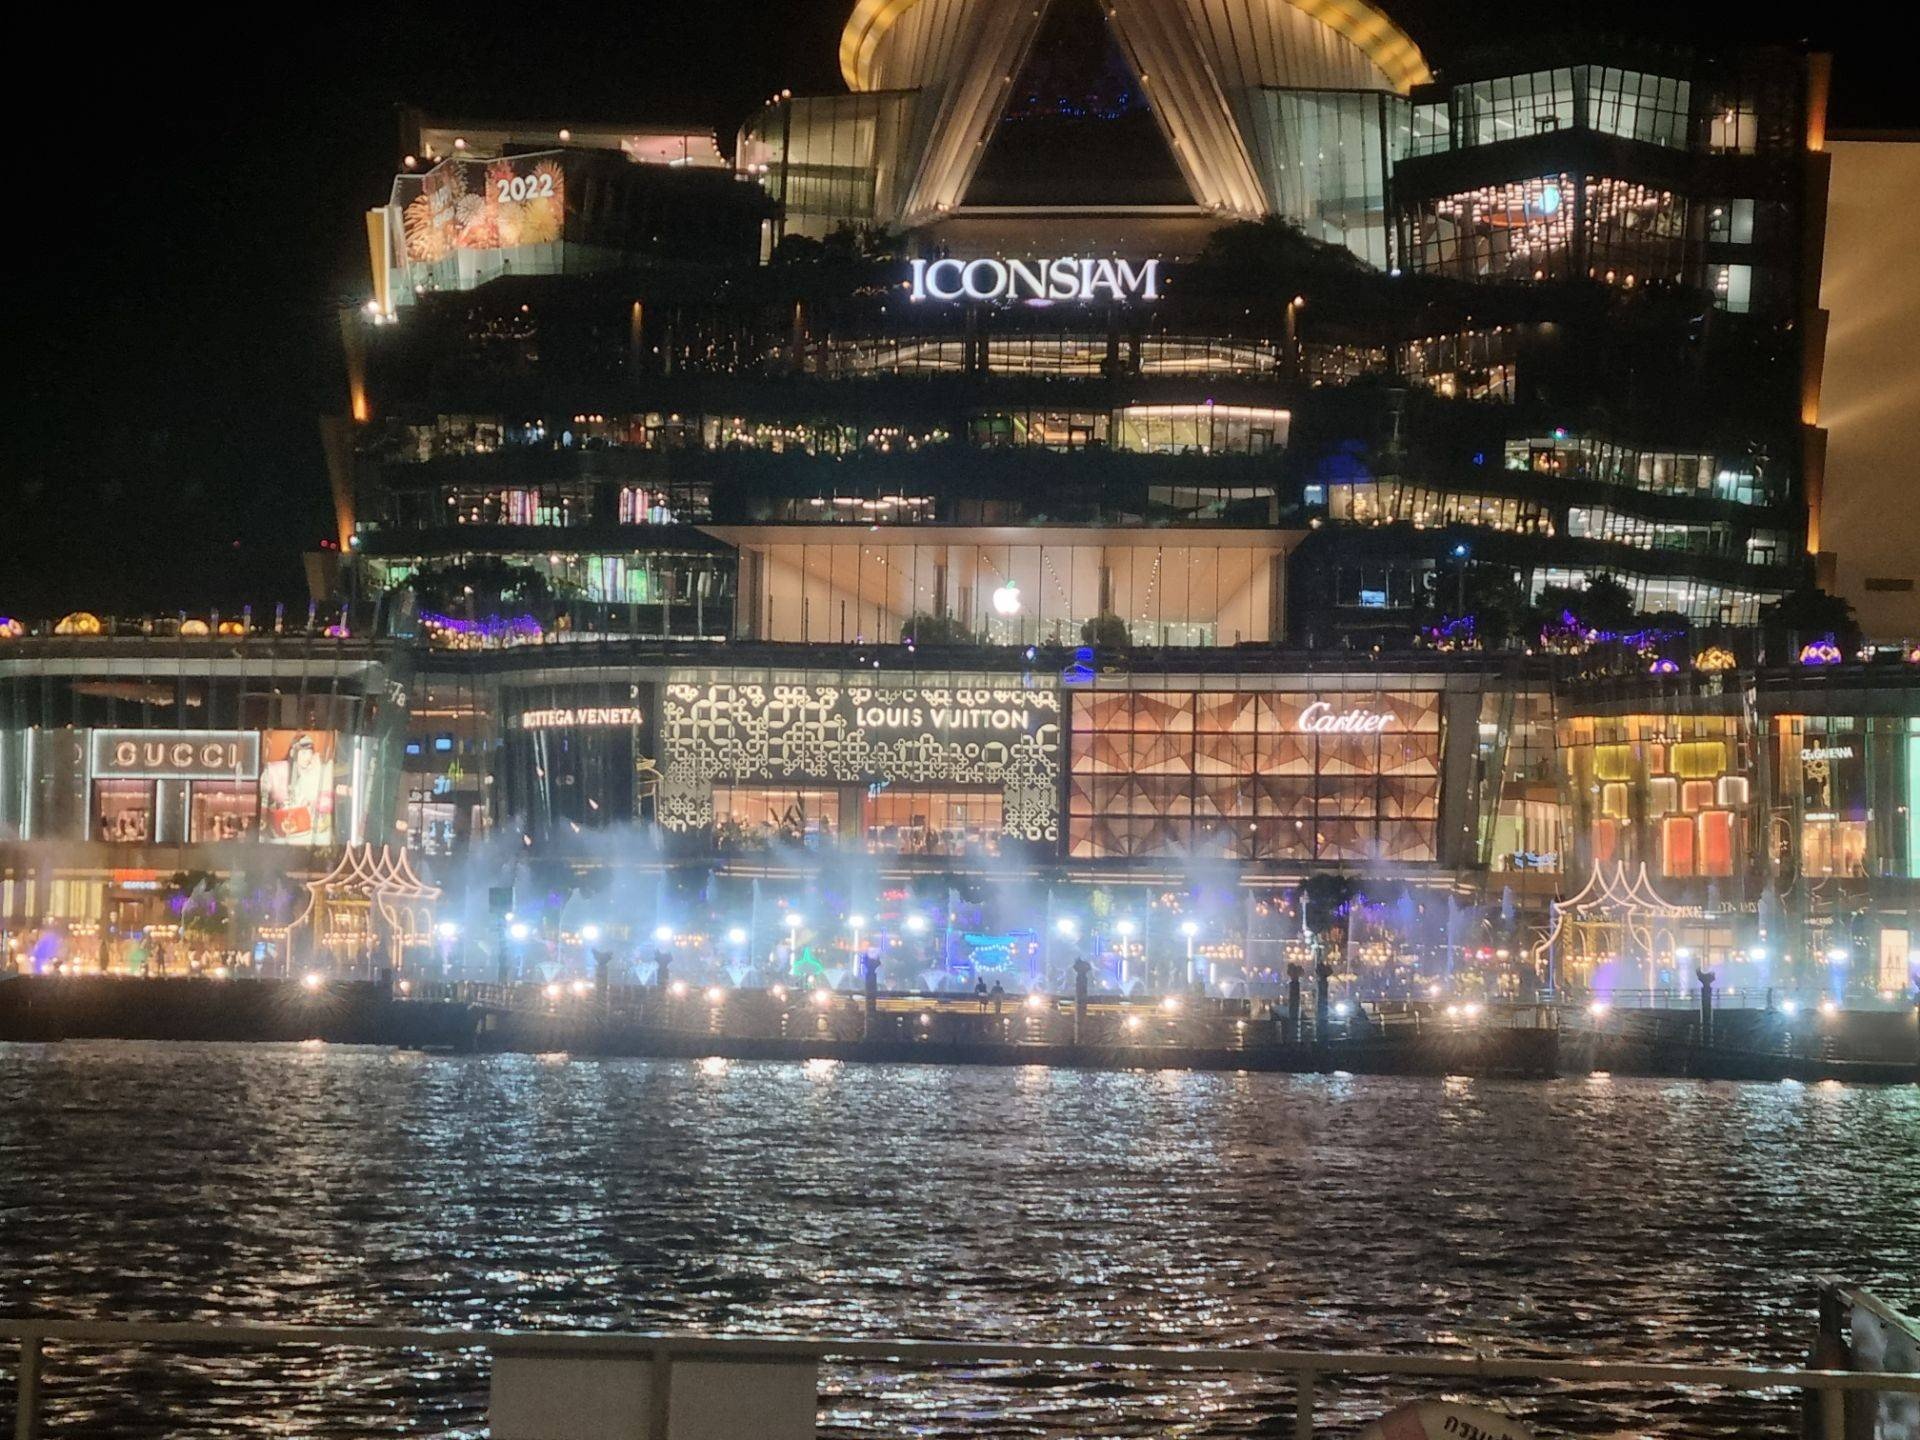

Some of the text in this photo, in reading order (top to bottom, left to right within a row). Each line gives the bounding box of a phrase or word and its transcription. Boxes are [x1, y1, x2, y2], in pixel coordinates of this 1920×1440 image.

[498, 174, 554, 203] 2022
[909, 258, 1159, 299] ICONSIAM
[577, 707, 643, 725] VENETA
[856, 707, 1029, 729] LOUIS VUITTON
[1299, 701, 1395, 732] Cartier
[115, 741, 238, 769] GUCCI
